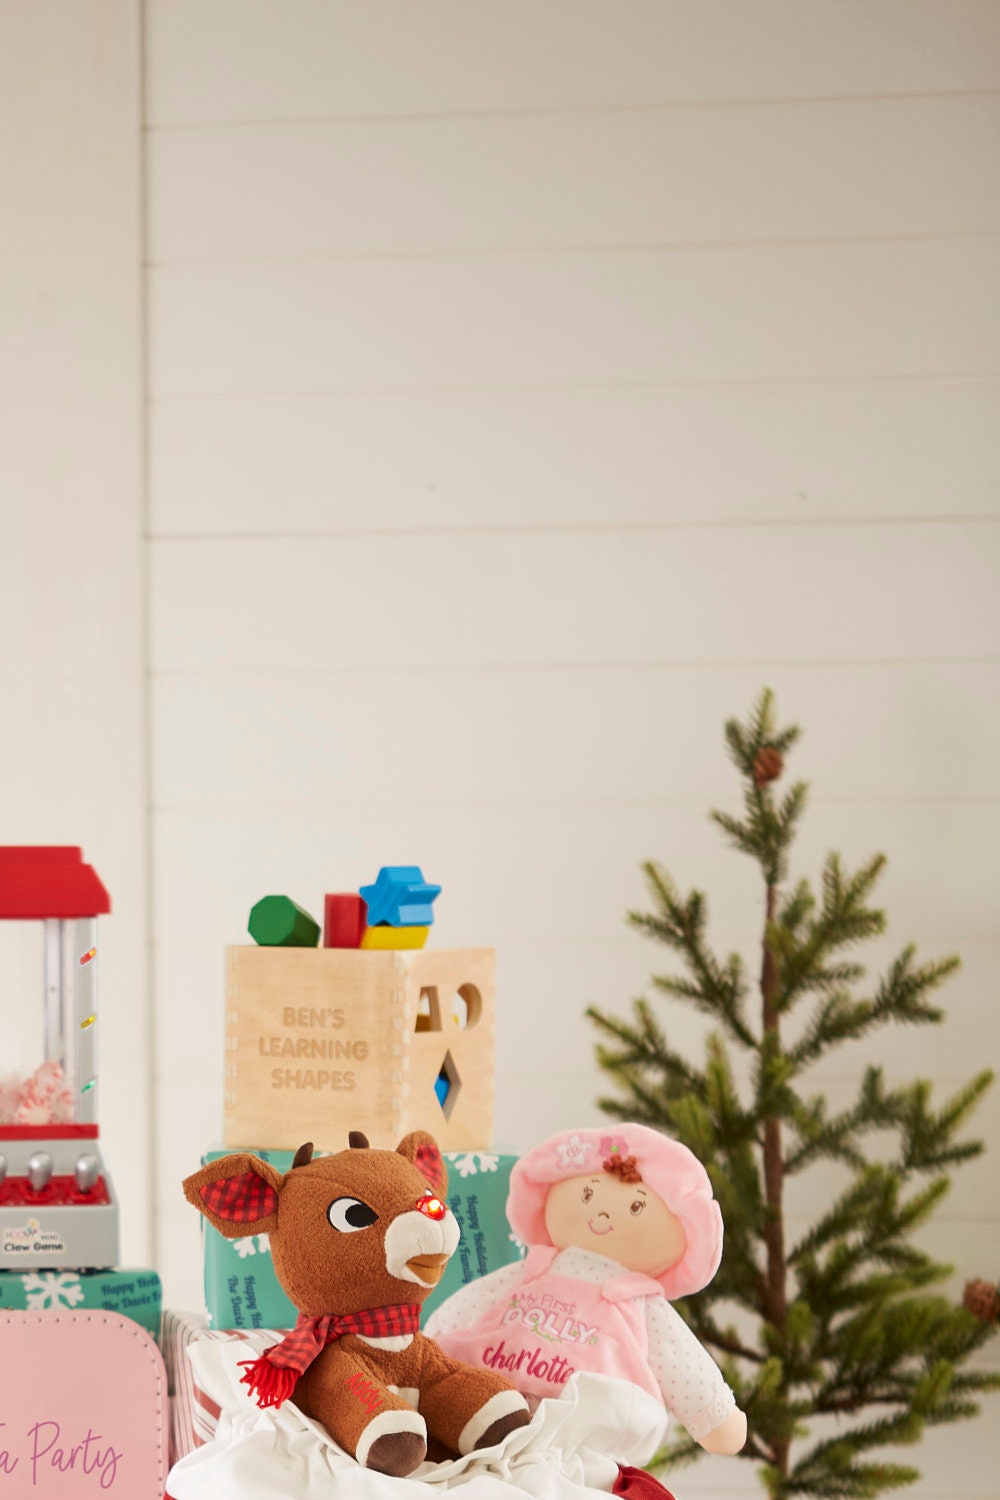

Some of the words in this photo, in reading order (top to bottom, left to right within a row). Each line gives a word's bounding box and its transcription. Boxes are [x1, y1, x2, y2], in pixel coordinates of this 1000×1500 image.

[283, 1006, 345, 1029] BEN'S
[259, 1036, 369, 1061] LEARNING
[271, 1068, 356, 1092] SHAPES
[4, 1243, 30, 1252] Claw
[33, 1242, 64, 1251] Game
[501, 1306, 600, 1345] DOLLY
[482, 1340, 575, 1384] charlotte
[344, 1372, 385, 1415] Addy
[27, 1421, 124, 1489] Party
